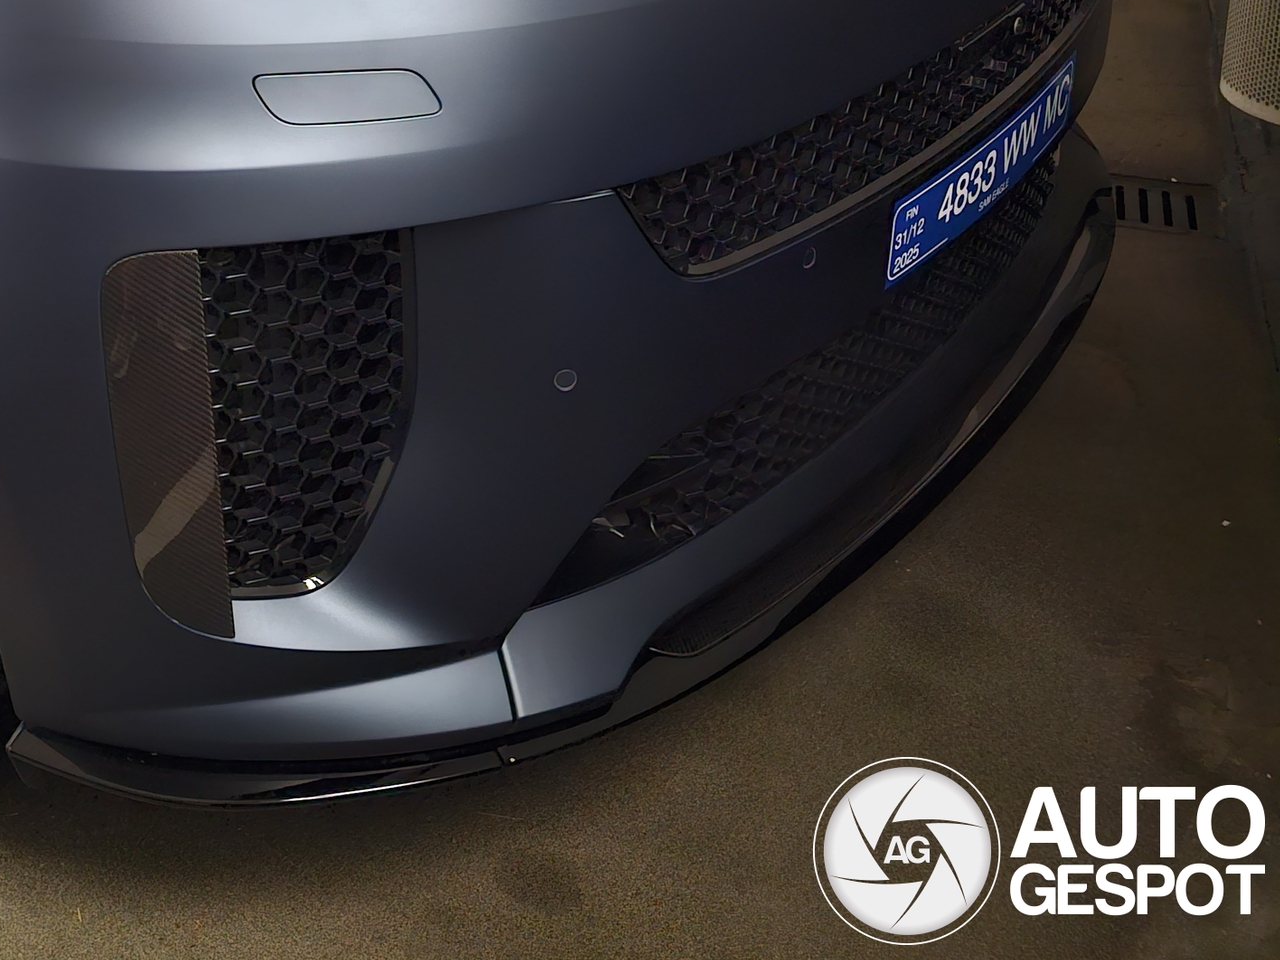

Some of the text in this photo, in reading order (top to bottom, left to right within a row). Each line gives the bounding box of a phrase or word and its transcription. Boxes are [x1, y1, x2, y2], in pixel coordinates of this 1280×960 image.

[938, 73, 1070, 223] 4833 WW MC
[905, 204, 919, 222] FIN
[894, 217, 925, 251] 31/12
[892, 242, 921, 275] 2025
